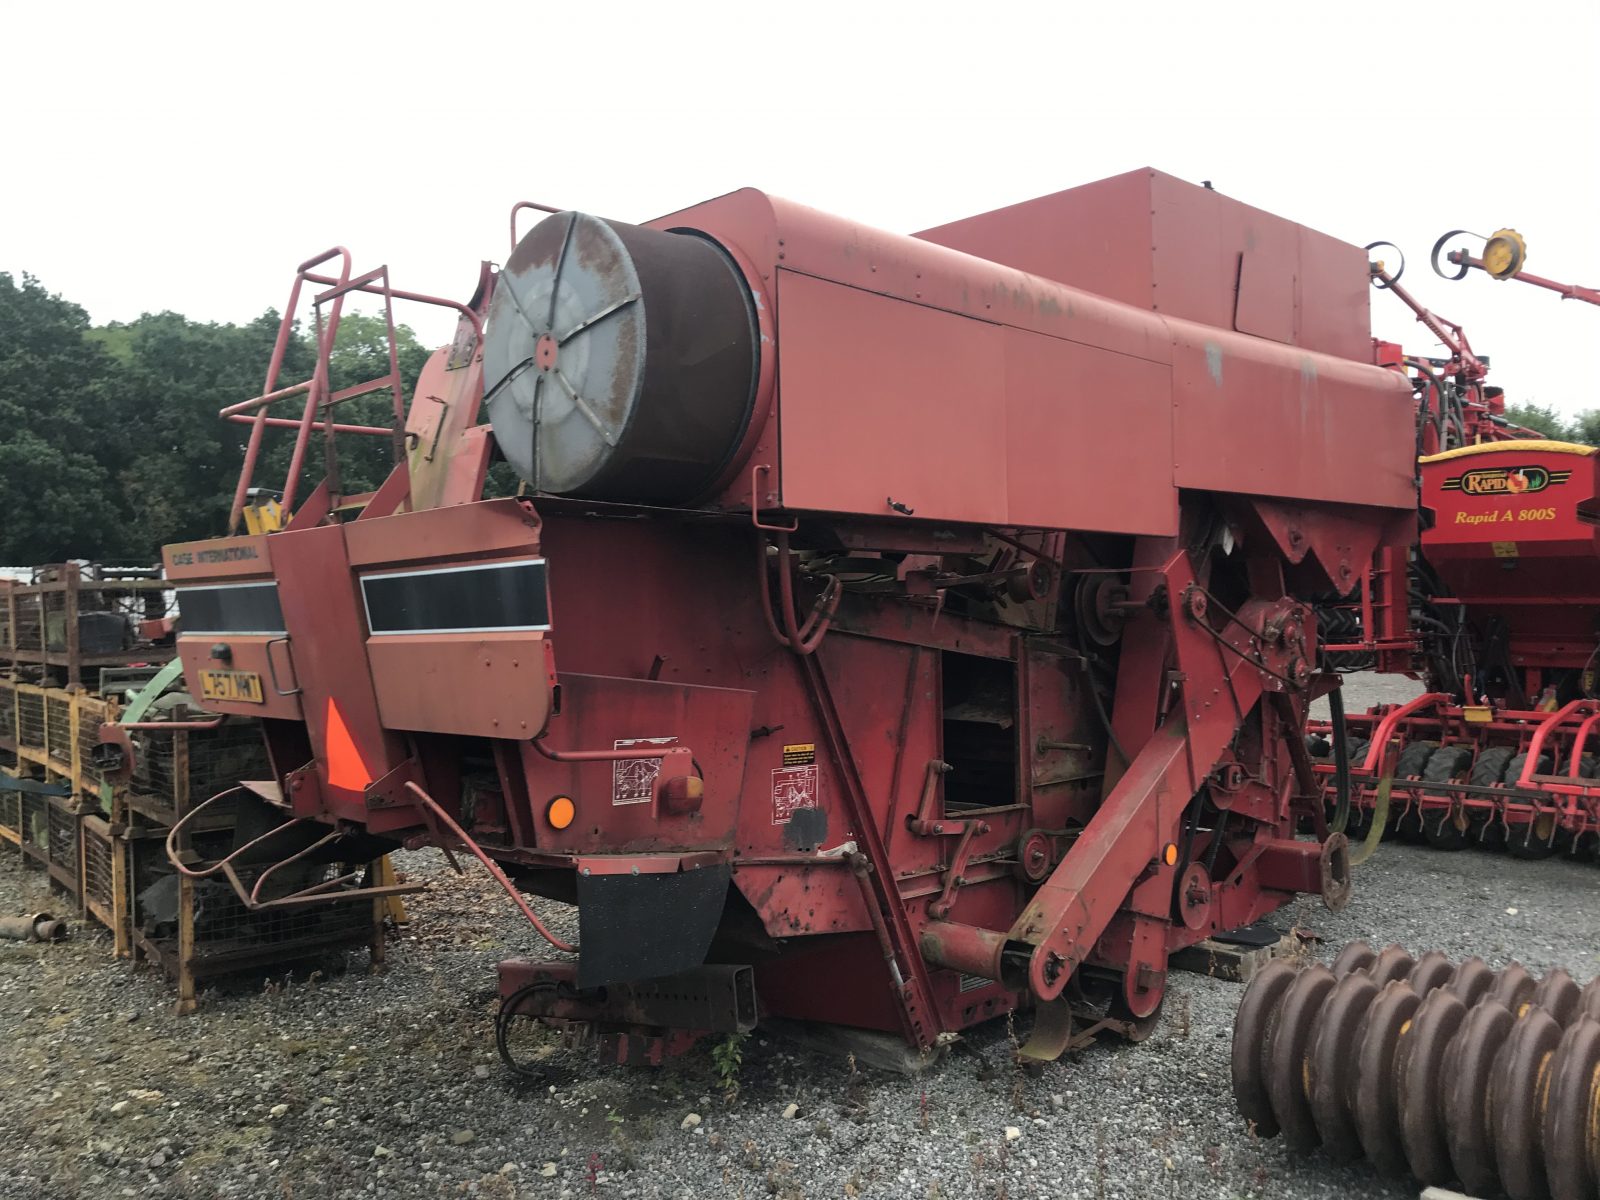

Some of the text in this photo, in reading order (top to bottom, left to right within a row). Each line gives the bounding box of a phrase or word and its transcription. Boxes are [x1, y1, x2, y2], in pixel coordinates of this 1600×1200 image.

[1468, 475, 1506, 493] RAPID
[1454, 507, 1557, 525] Rapid A 800S
[197, 546, 259, 563] INTERNATIONAL
